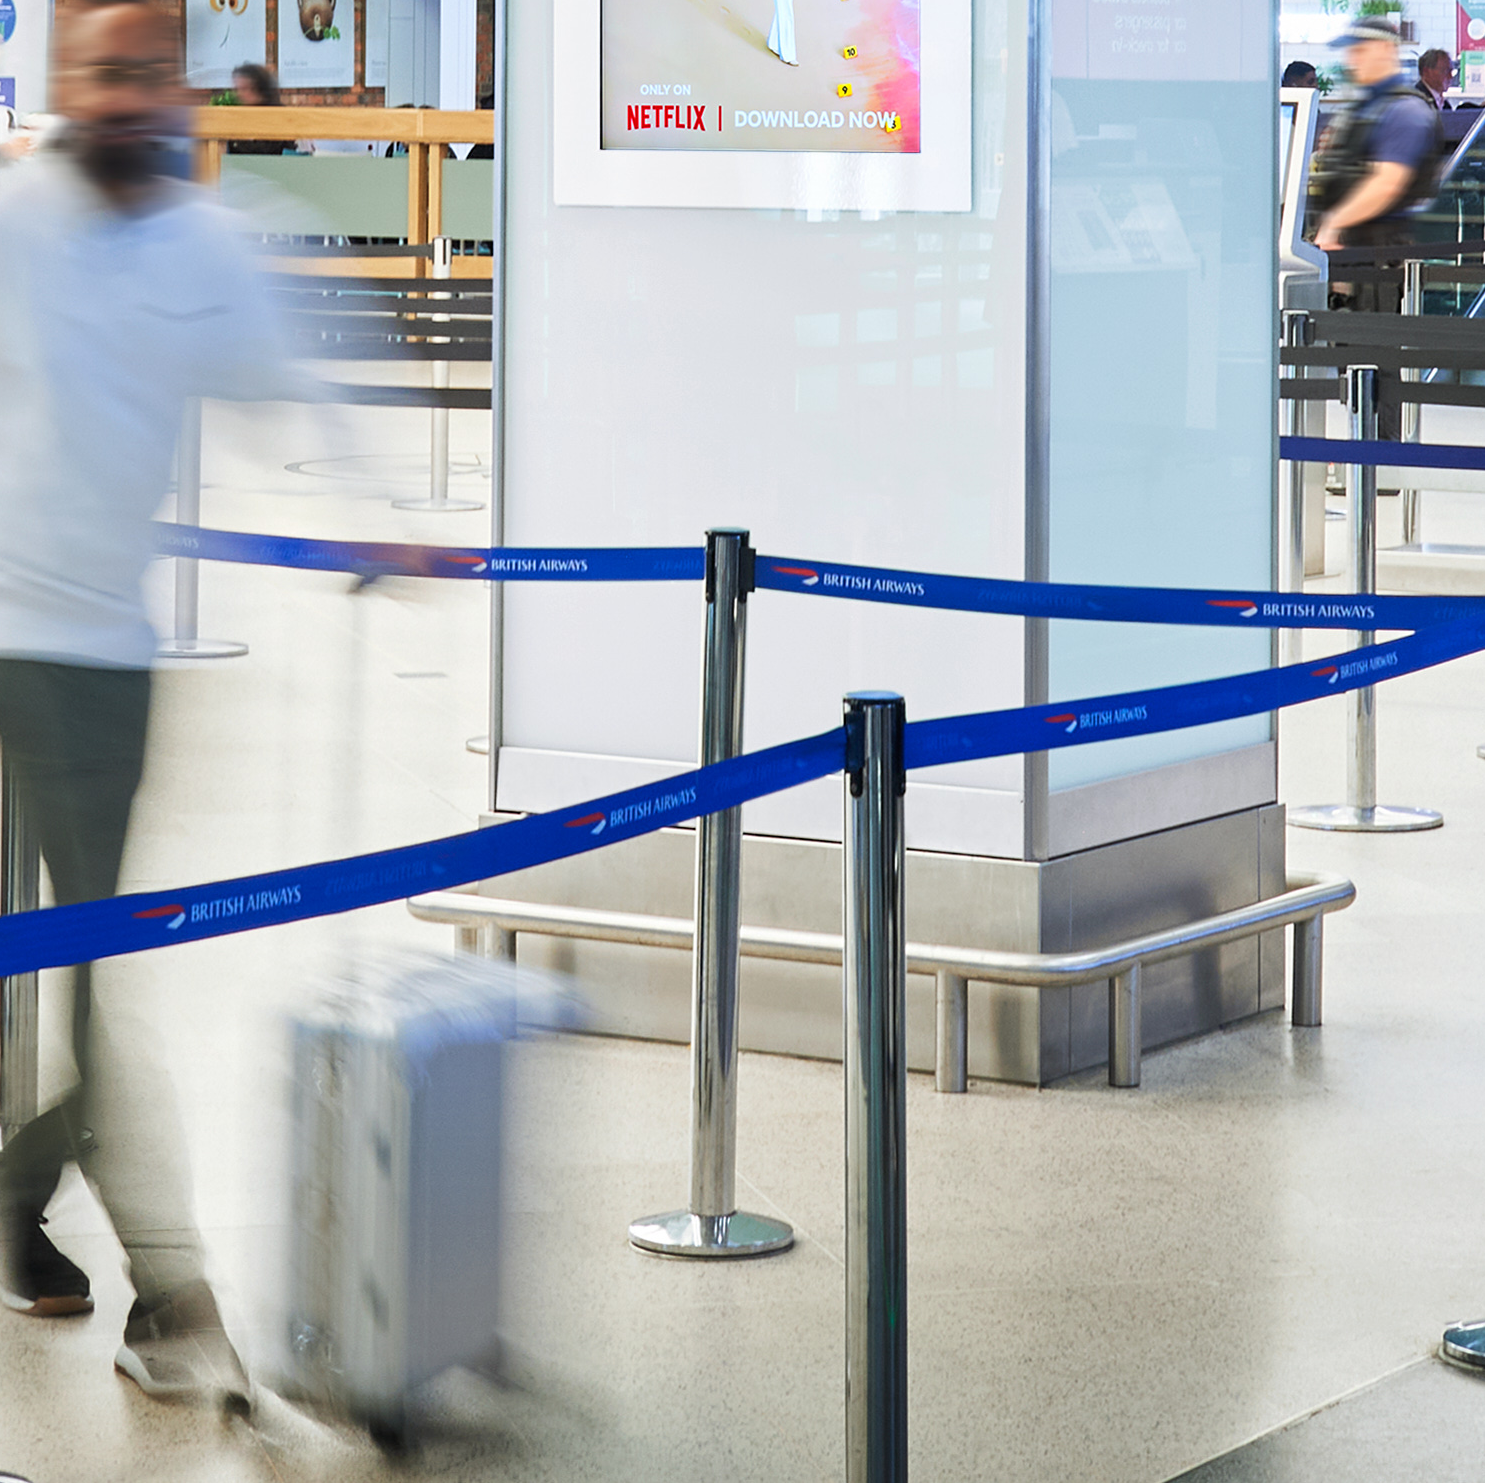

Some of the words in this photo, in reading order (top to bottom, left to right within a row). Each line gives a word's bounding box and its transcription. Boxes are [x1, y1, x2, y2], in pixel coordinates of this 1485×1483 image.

[846, 48, 856, 57] 10
[640, 84, 672, 96] ONLY
[673, 84, 691, 96] ON
[627, 104, 706, 132] NETFLIX
[734, 110, 845, 129] DOWNLOAD
[848, 110, 897, 130] NOW
[491, 558, 537, 572] BRITISH
[538, 558, 589, 572] AIRWAYS
[823, 573, 871, 591] BRITISH
[873, 578, 925, 596] AIRWAYS
[1263, 603, 1315, 618] BRITISH
[1317, 603, 1375, 619] AIRWAYS
[1340, 660, 1368, 680] BRITISH
[1369, 651, 1399, 672] AIRWAYS
[1079, 710, 1112, 730] BRITISH
[1113, 705, 1148, 724] AIRWAYS
[610, 798, 653, 828] BRITISH
[654, 786, 697, 814] AIRWAYS
[190, 898, 245, 924] BRITISH
[246, 884, 302, 912] AIRWAYS
